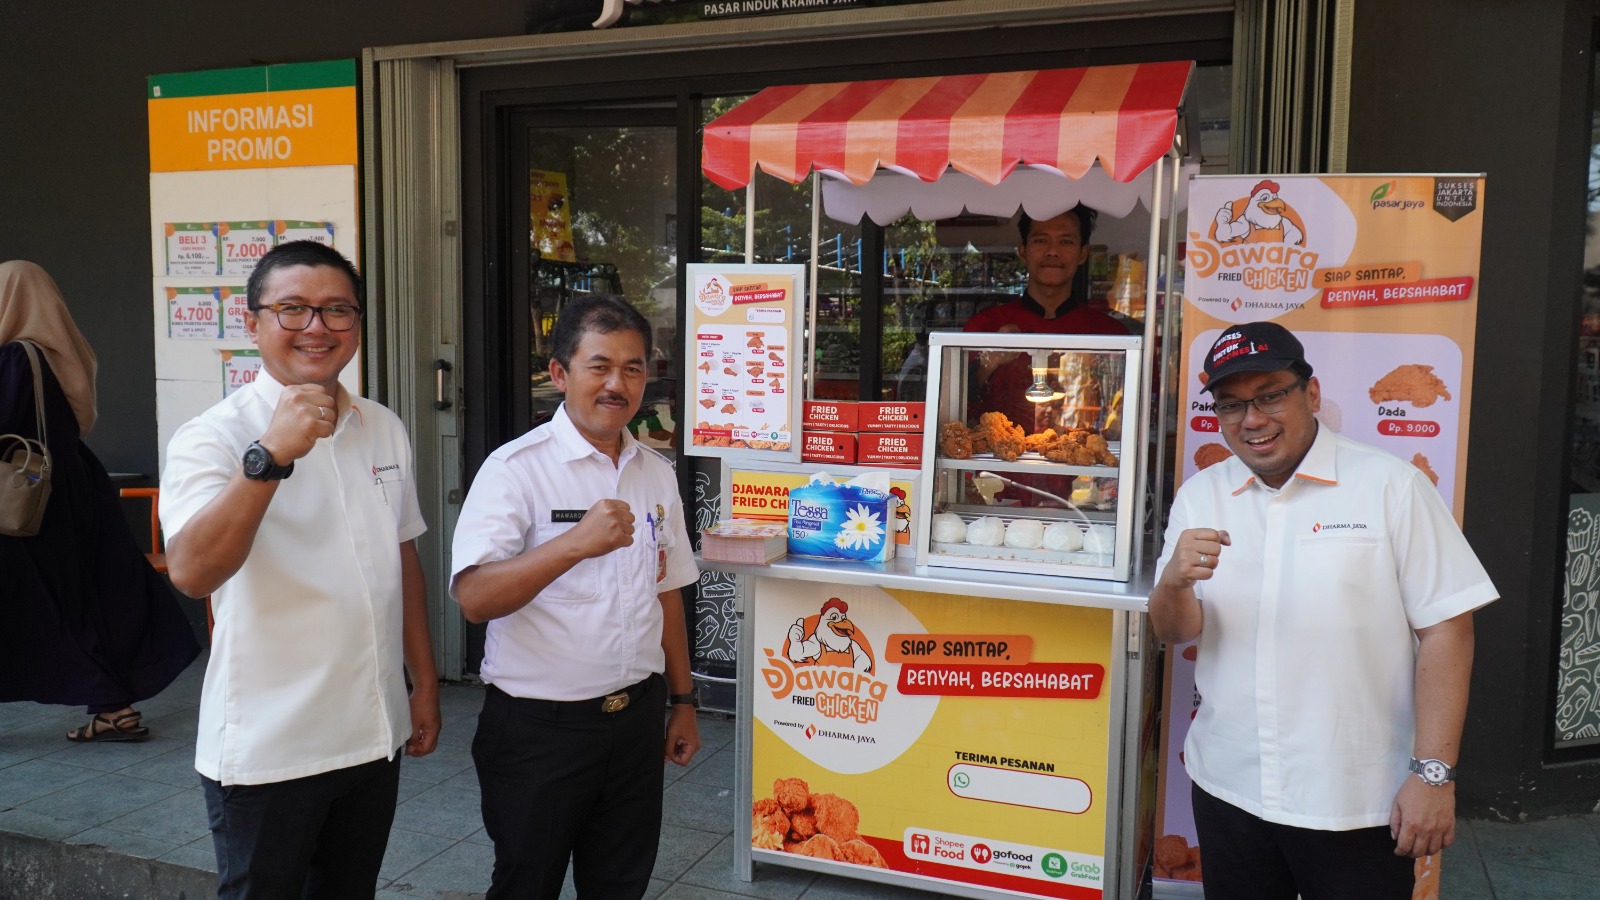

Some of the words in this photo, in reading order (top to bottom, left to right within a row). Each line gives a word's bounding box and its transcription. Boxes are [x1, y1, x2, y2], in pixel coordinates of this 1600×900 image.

[704, 2, 740, 15] PASAR
[742, 0, 779, 12] INDUK
[187, 104, 313, 133] INFORMASI
[207, 136, 292, 162] PROMO
[178, 235, 199, 245] BELI
[201, 235, 207, 244] 3
[226, 244, 267, 257] 7.000
[1218, 272, 1242, 282] FRIED
[1243, 267, 1309, 292] CHICKEN
[1324, 270, 1351, 283] SIAP
[1355, 267, 1406, 281] SANTAP,
[1327, 289, 1379, 303] RENYAH,
[1383, 283, 1466, 300] BERSAHABAT
[1245, 301, 1284, 309] DHARMA
[1285, 302, 1305, 311] JAYA
[174, 307, 213, 321] 4.700
[811, 406, 838, 414] FRIED
[880, 406, 907, 415] FRIED
[1192, 401, 1216, 412] Pah
[1378, 406, 1406, 417] Dada
[1201, 420, 1214, 430] Rp.
[1388, 422, 1404, 434] Rp.
[1406, 423, 1436, 433] 9.000
[807, 436, 833, 446] FRIED
[879, 438, 906, 446] FRIED
[806, 444, 834, 452] CHICKEN
[732, 483, 790, 497] DJAWARA
[732, 496, 768, 509] FRIED
[792, 498, 828, 520] Tessa
[900, 640, 936, 656] SIAP
[942, 641, 1010, 660] SANTAP,
[907, 670, 975, 690] RENYAH,
[981, 671, 1094, 691] BERSAHABAT
[792, 695, 815, 706] FRIED
[816, 692, 878, 724] CHICKEN
[774, 720, 797, 728] Powered
[818, 730, 856, 742] DHARMA
[856, 733, 876, 744] JAYA
[955, 750, 998, 766] TERIMA
[1000, 757, 1055, 773] PESANAN
[934, 836, 965, 849] Shopee
[934, 846, 965, 861] Food
[992, 850, 1033, 862] gofood
[1070, 861, 1101, 874] Grab
[1070, 872, 1100, 881] GrabFood
